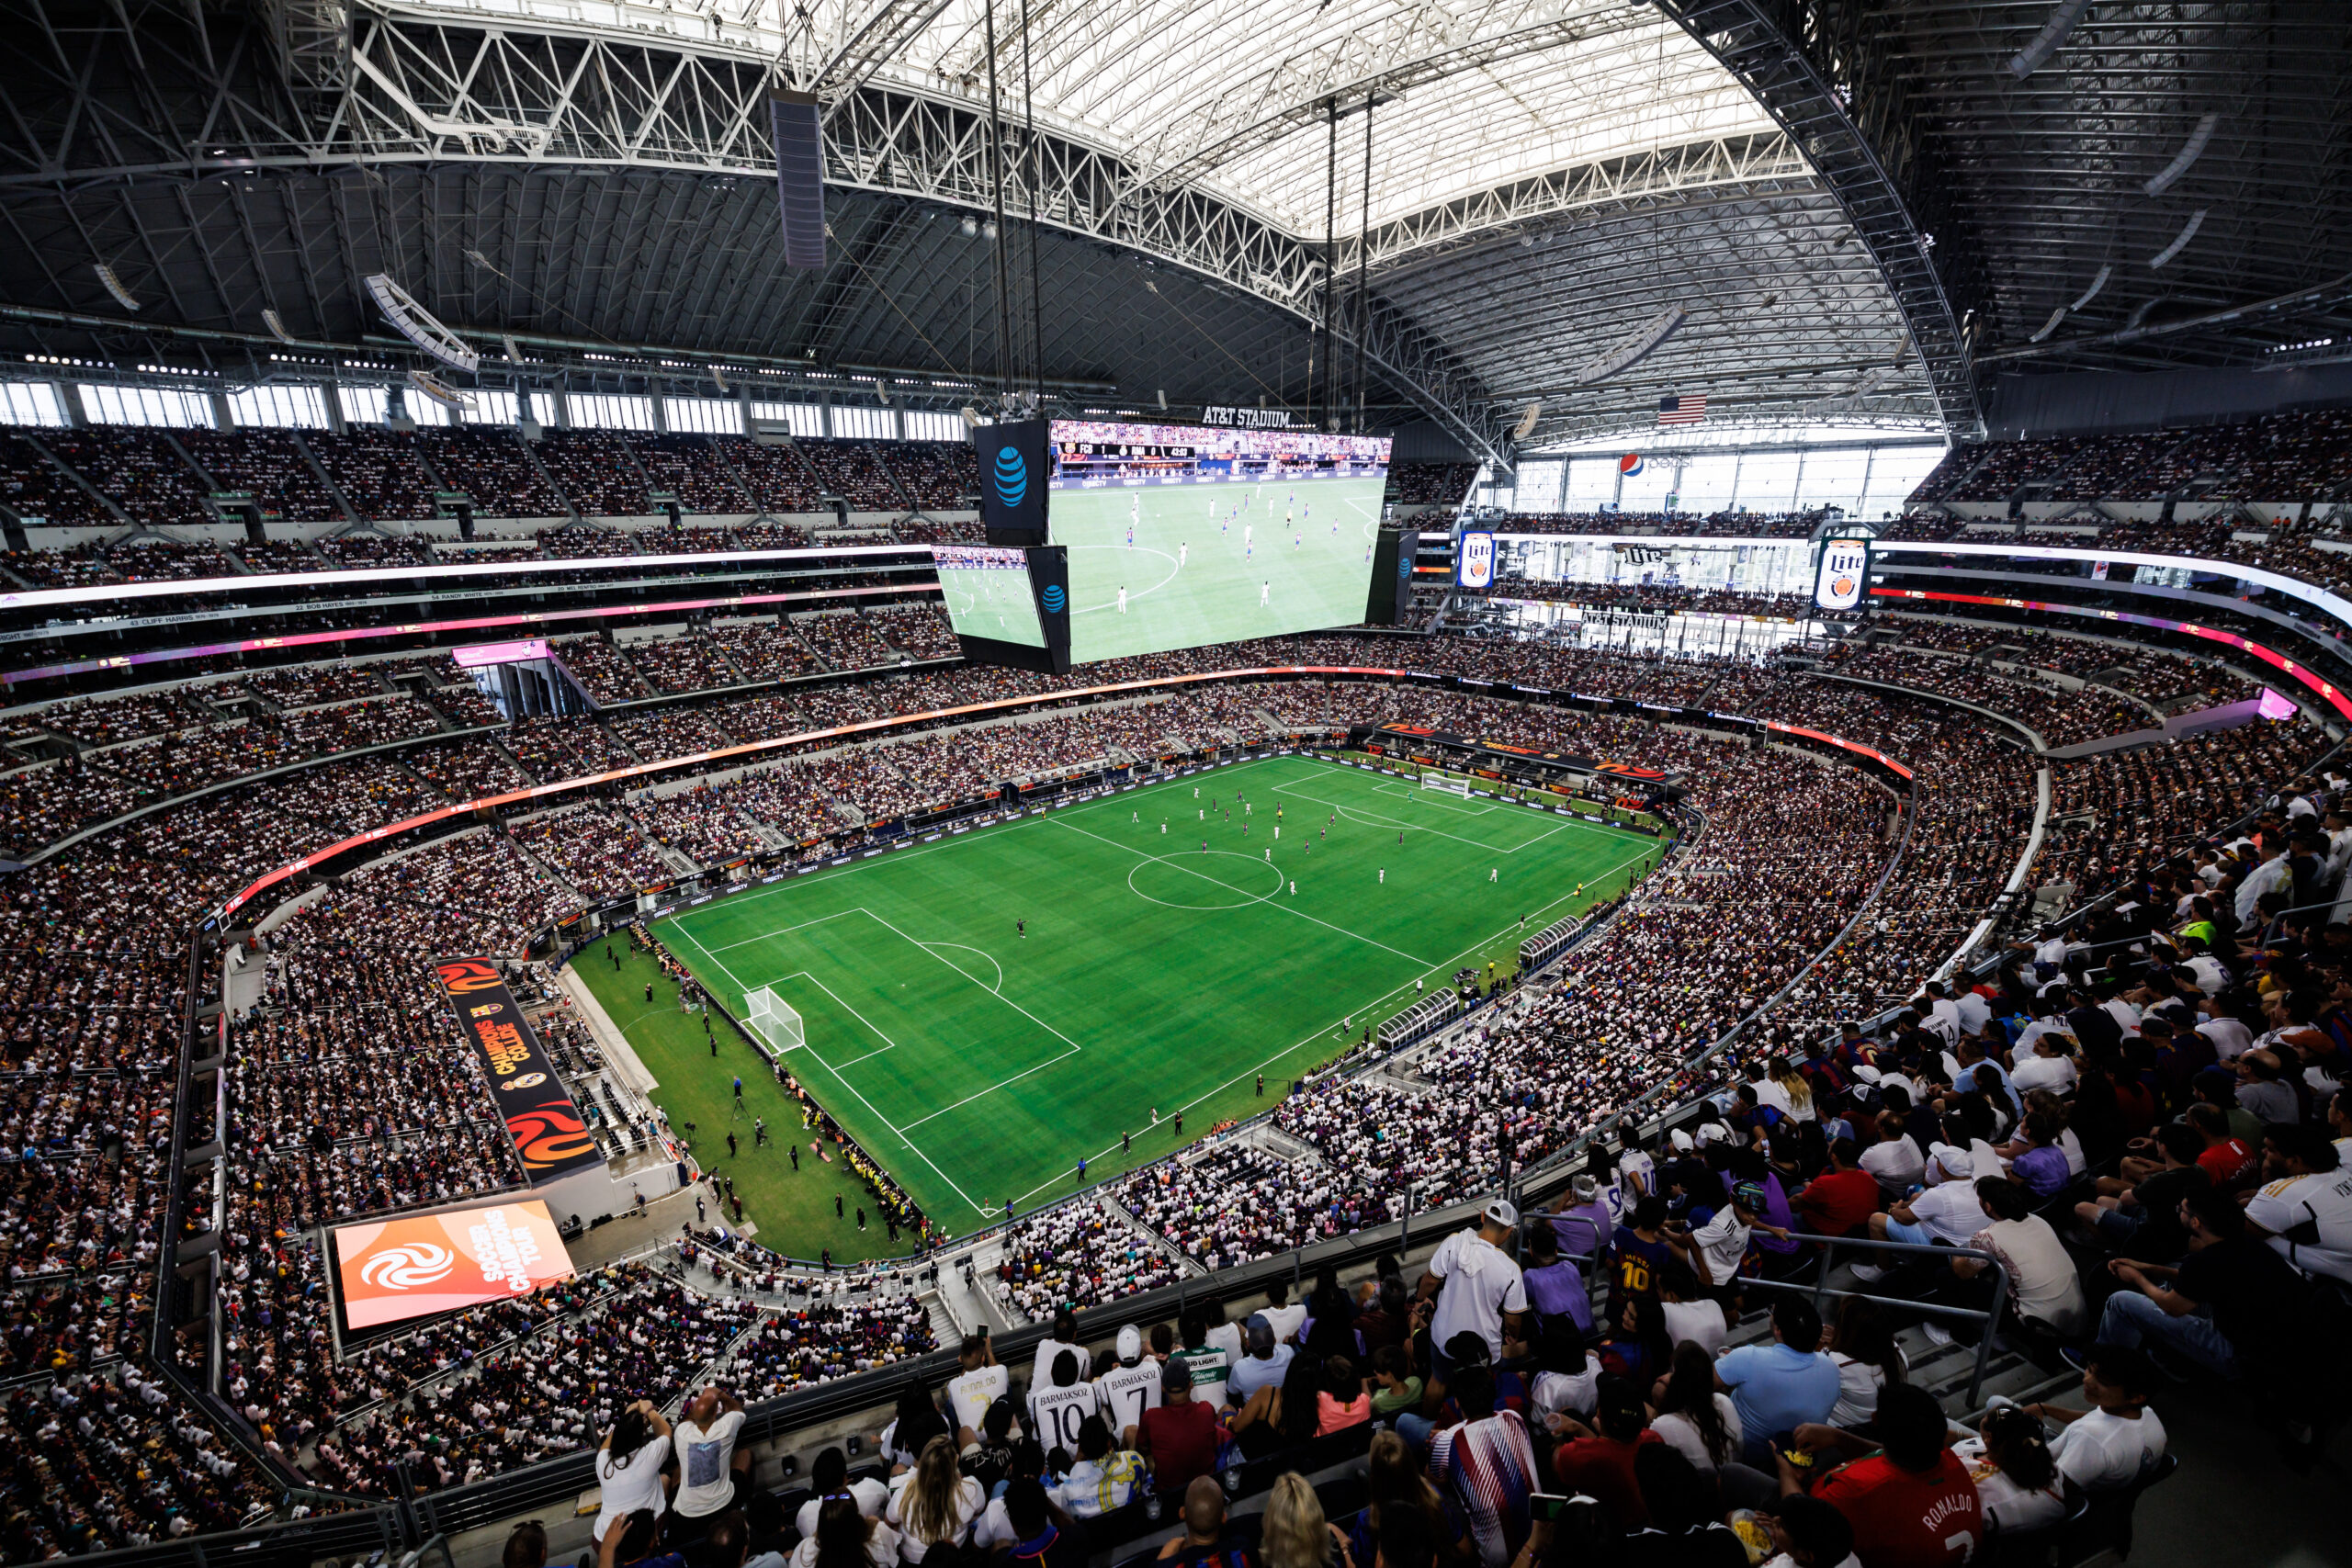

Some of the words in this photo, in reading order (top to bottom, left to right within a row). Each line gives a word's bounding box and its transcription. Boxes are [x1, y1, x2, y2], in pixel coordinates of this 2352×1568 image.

[1202, 406, 1236, 425] AT&T
[1237, 408, 1290, 429] STADIUM
[1080, 444, 1093, 455] FCB
[1102, 445, 1105, 455] 1
[1150, 447, 1156, 457] 0
[1648, 456, 1694, 473] pepsi
[1468, 545, 1491, 558] Lite
[1623, 547, 1663, 567] Lite
[1830, 555, 1863, 573] Lite
[165, 615, 195, 623] HARRIS
[1581, 613, 1610, 626] AT&T
[1612, 615, 1668, 630] STADIUM
[1516, 685, 1551, 694] Blockchain.com
[1577, 694, 1614, 704] Blockchain.com
[1642, 702, 1683, 714] Blockchain.com
[1714, 713, 1757, 724] Blockchain.com
[1527, 801, 1544, 810] DIRECTV
[1555, 808, 1573, 817] DIRECTV
[1584, 814, 1602, 823] DIRECTV
[831, 857, 851, 866] DIRECTV
[864, 849, 882, 858] DIRECTV
[797, 865, 818, 874] DIRECTV
[763, 874, 783, 884] DIRECTV
[727, 884, 748, 894] DIRECTV
[691, 895, 712, 906] DIRECTV
[474, 1020, 516, 1075] CHAMPIONS
[496, 1021, 531, 1062] COLLIDE
[1608, 1187, 1622, 1218] 9
[469, 1224, 505, 1282] SOCCER
[483, 1210, 531, 1292] CHAMPIONS
[512, 1225, 542, 1266] TOUR
[1624, 1253, 1651, 1270] MESSI
[1621, 1261, 1650, 1292] 10
[960, 1376, 997, 1396] RONALDO
[1112, 1371, 1157, 1391] BARMAKSOZ
[1040, 1388, 1089, 1407] BARMAKSOZ
[1126, 1385, 1148, 1422] 7
[970, 1393, 992, 1432] 7
[1046, 1404, 1086, 1448] 10
[1922, 1493, 1972, 1532] RONALDO
[1944, 1529, 1975, 1565] 7
